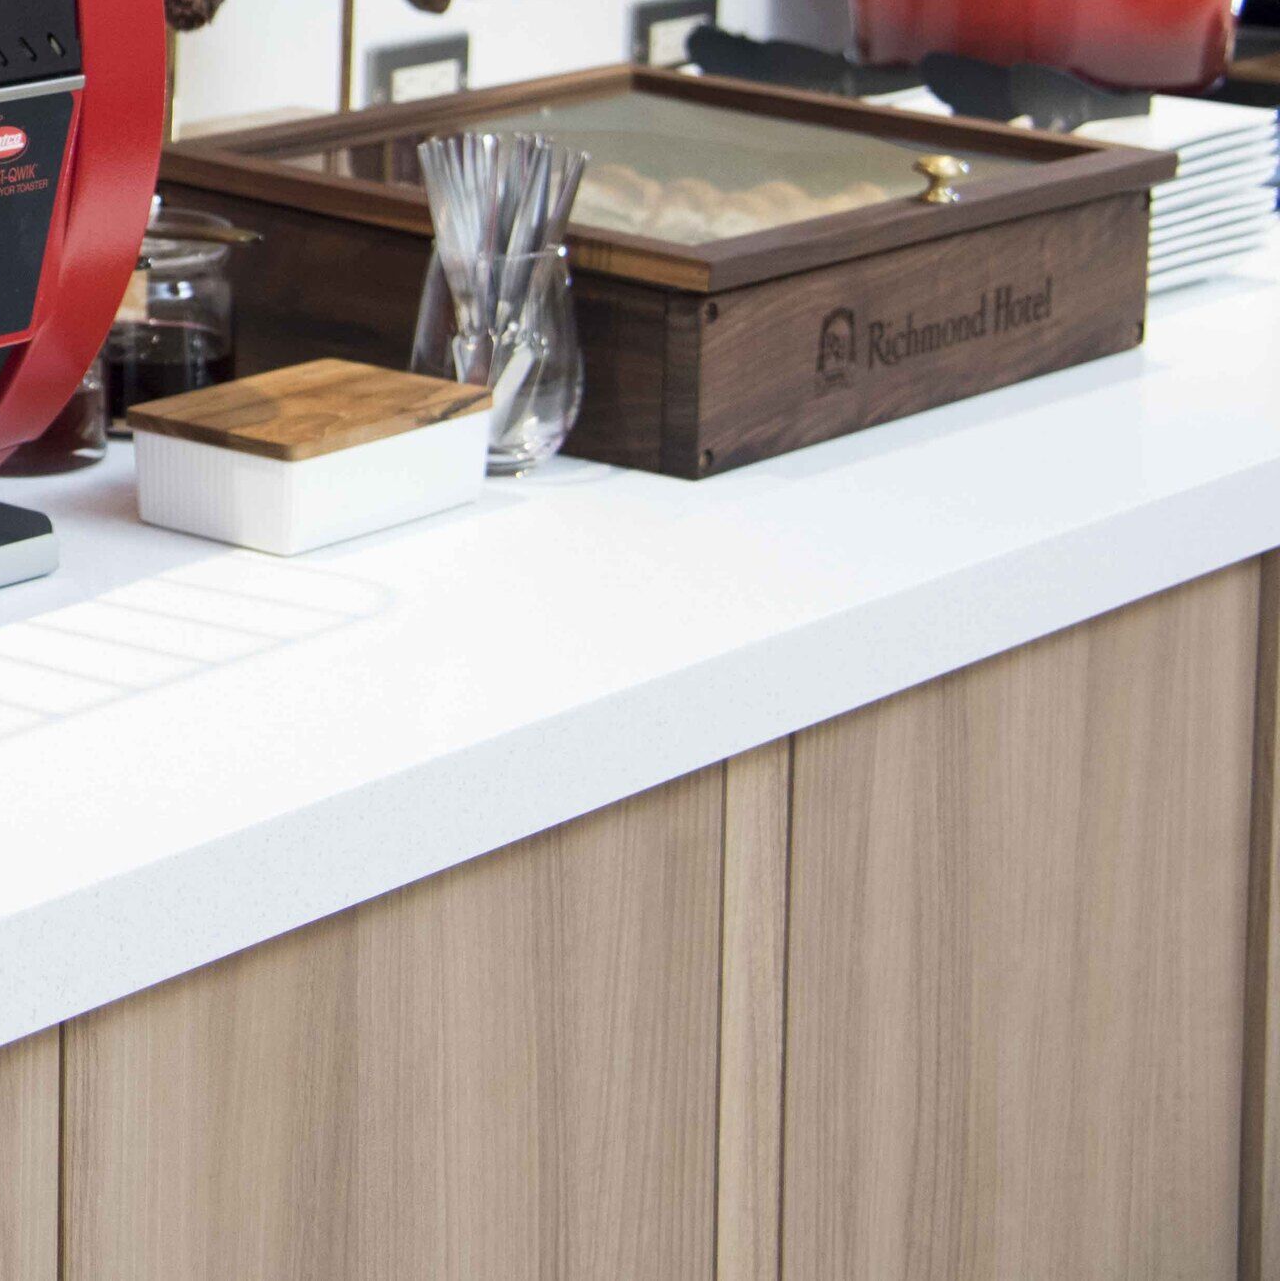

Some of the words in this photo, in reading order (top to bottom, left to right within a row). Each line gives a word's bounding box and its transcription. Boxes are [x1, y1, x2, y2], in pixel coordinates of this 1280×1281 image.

[16, 178, 48, 194] TOASTER
[866, 291, 987, 369] Richmond
[992, 274, 1052, 334] Hotel
